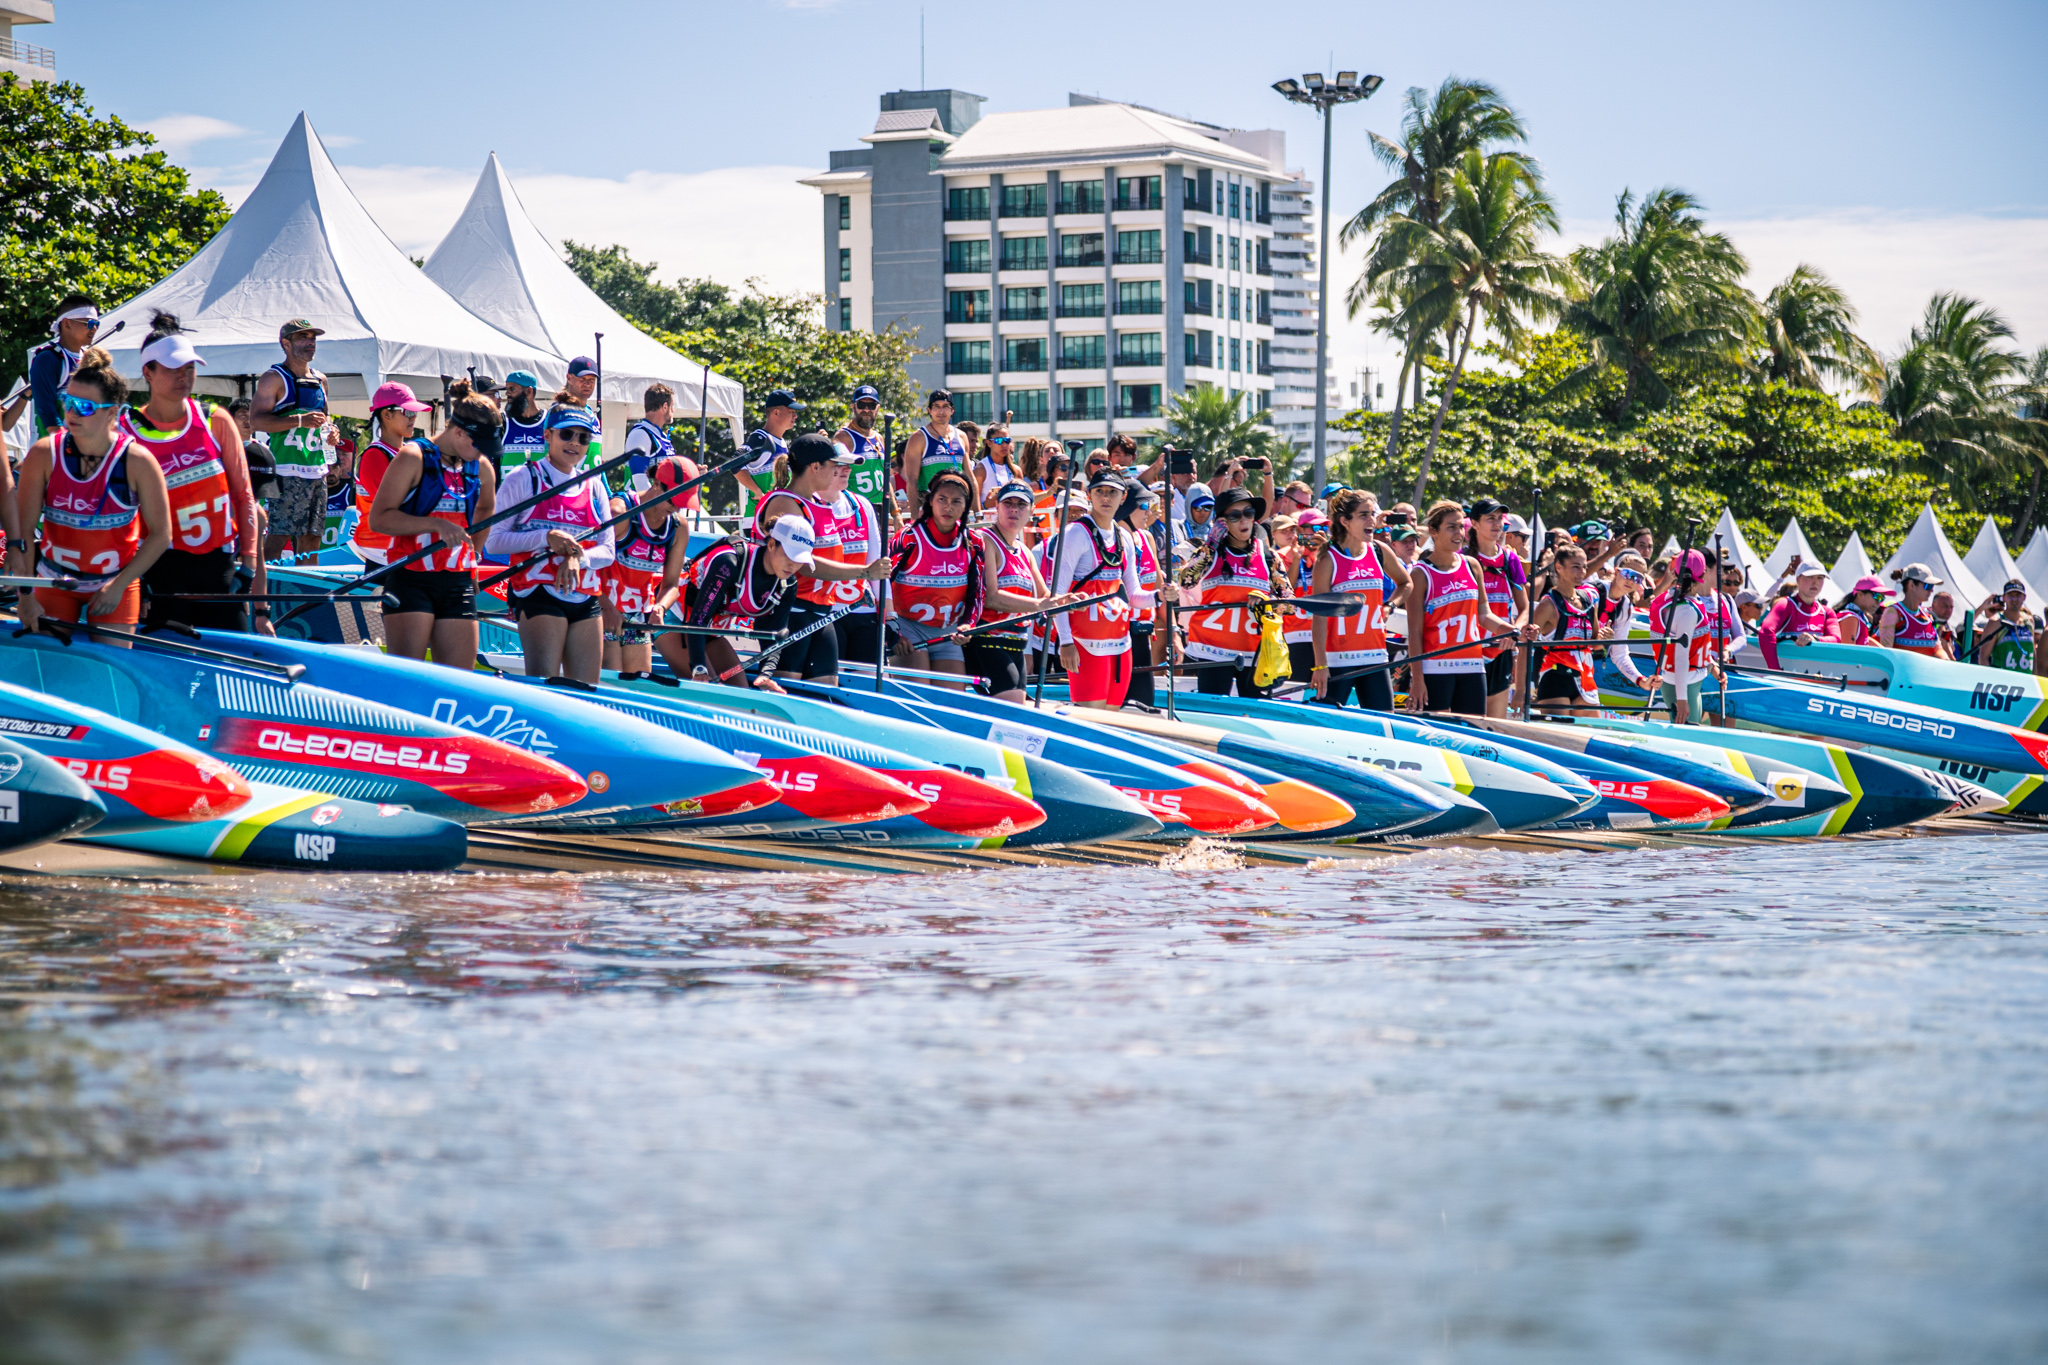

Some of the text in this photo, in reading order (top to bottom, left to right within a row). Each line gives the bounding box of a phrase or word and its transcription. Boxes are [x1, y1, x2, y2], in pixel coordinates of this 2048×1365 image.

[855, 470, 884, 494] 50
[176, 493, 233, 547] 57
[1970, 683, 2026, 712] NSP
[33, 722, 73, 738] BLACK
[1596, 782, 1650, 800] STA
[295, 832, 337, 862] NSP
